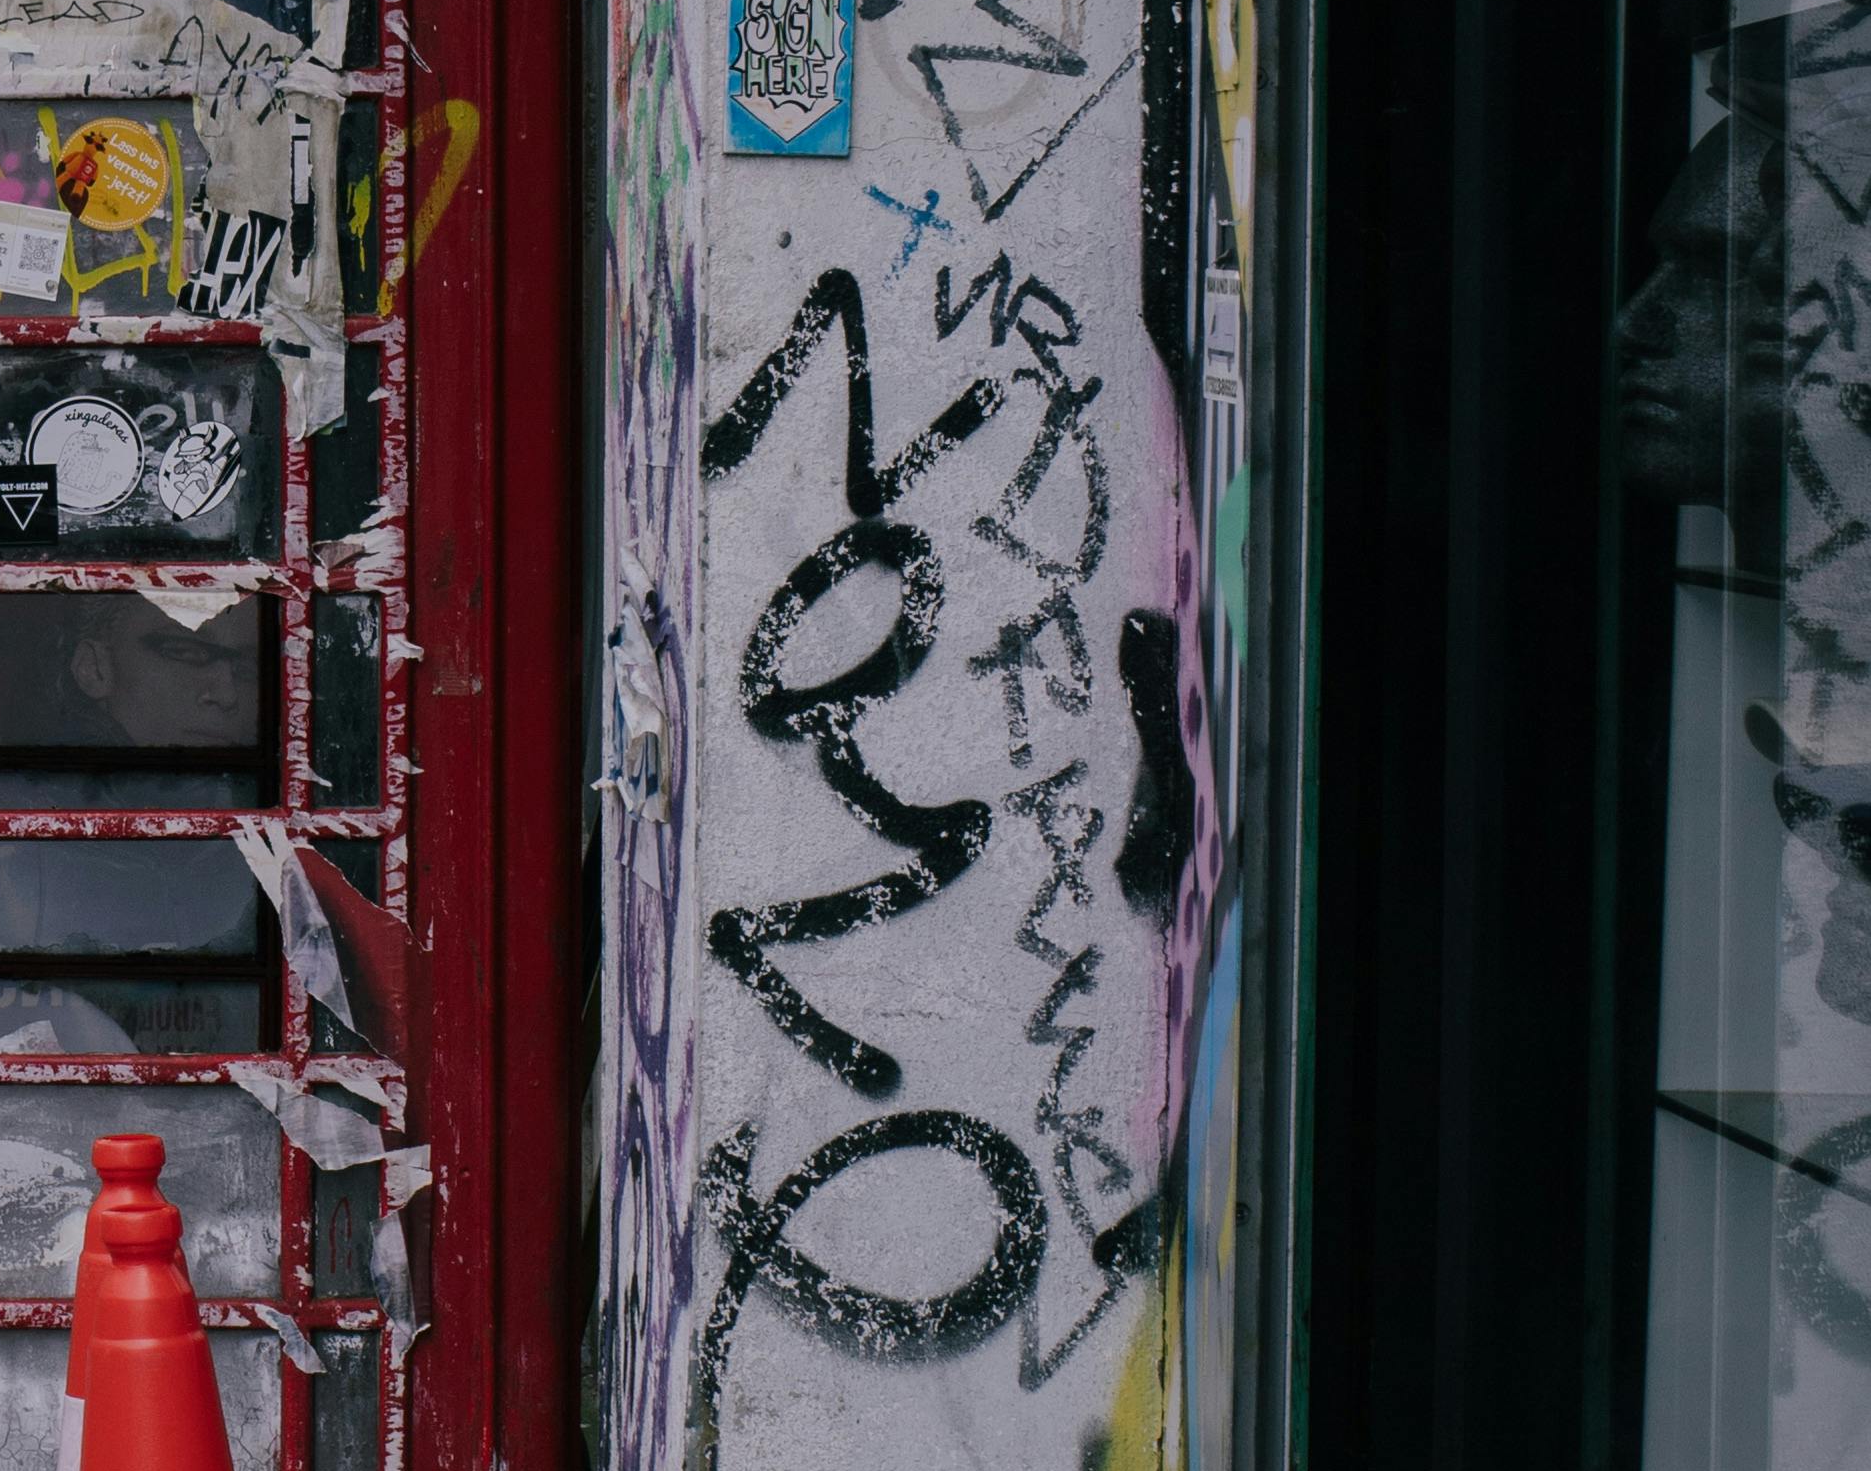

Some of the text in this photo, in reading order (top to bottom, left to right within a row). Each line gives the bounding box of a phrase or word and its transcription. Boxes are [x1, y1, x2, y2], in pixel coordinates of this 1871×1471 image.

[744, 50, 828, 98] HERE
[109, 133, 160, 170] Lass uns
[108, 154, 159, 190] verreisen
